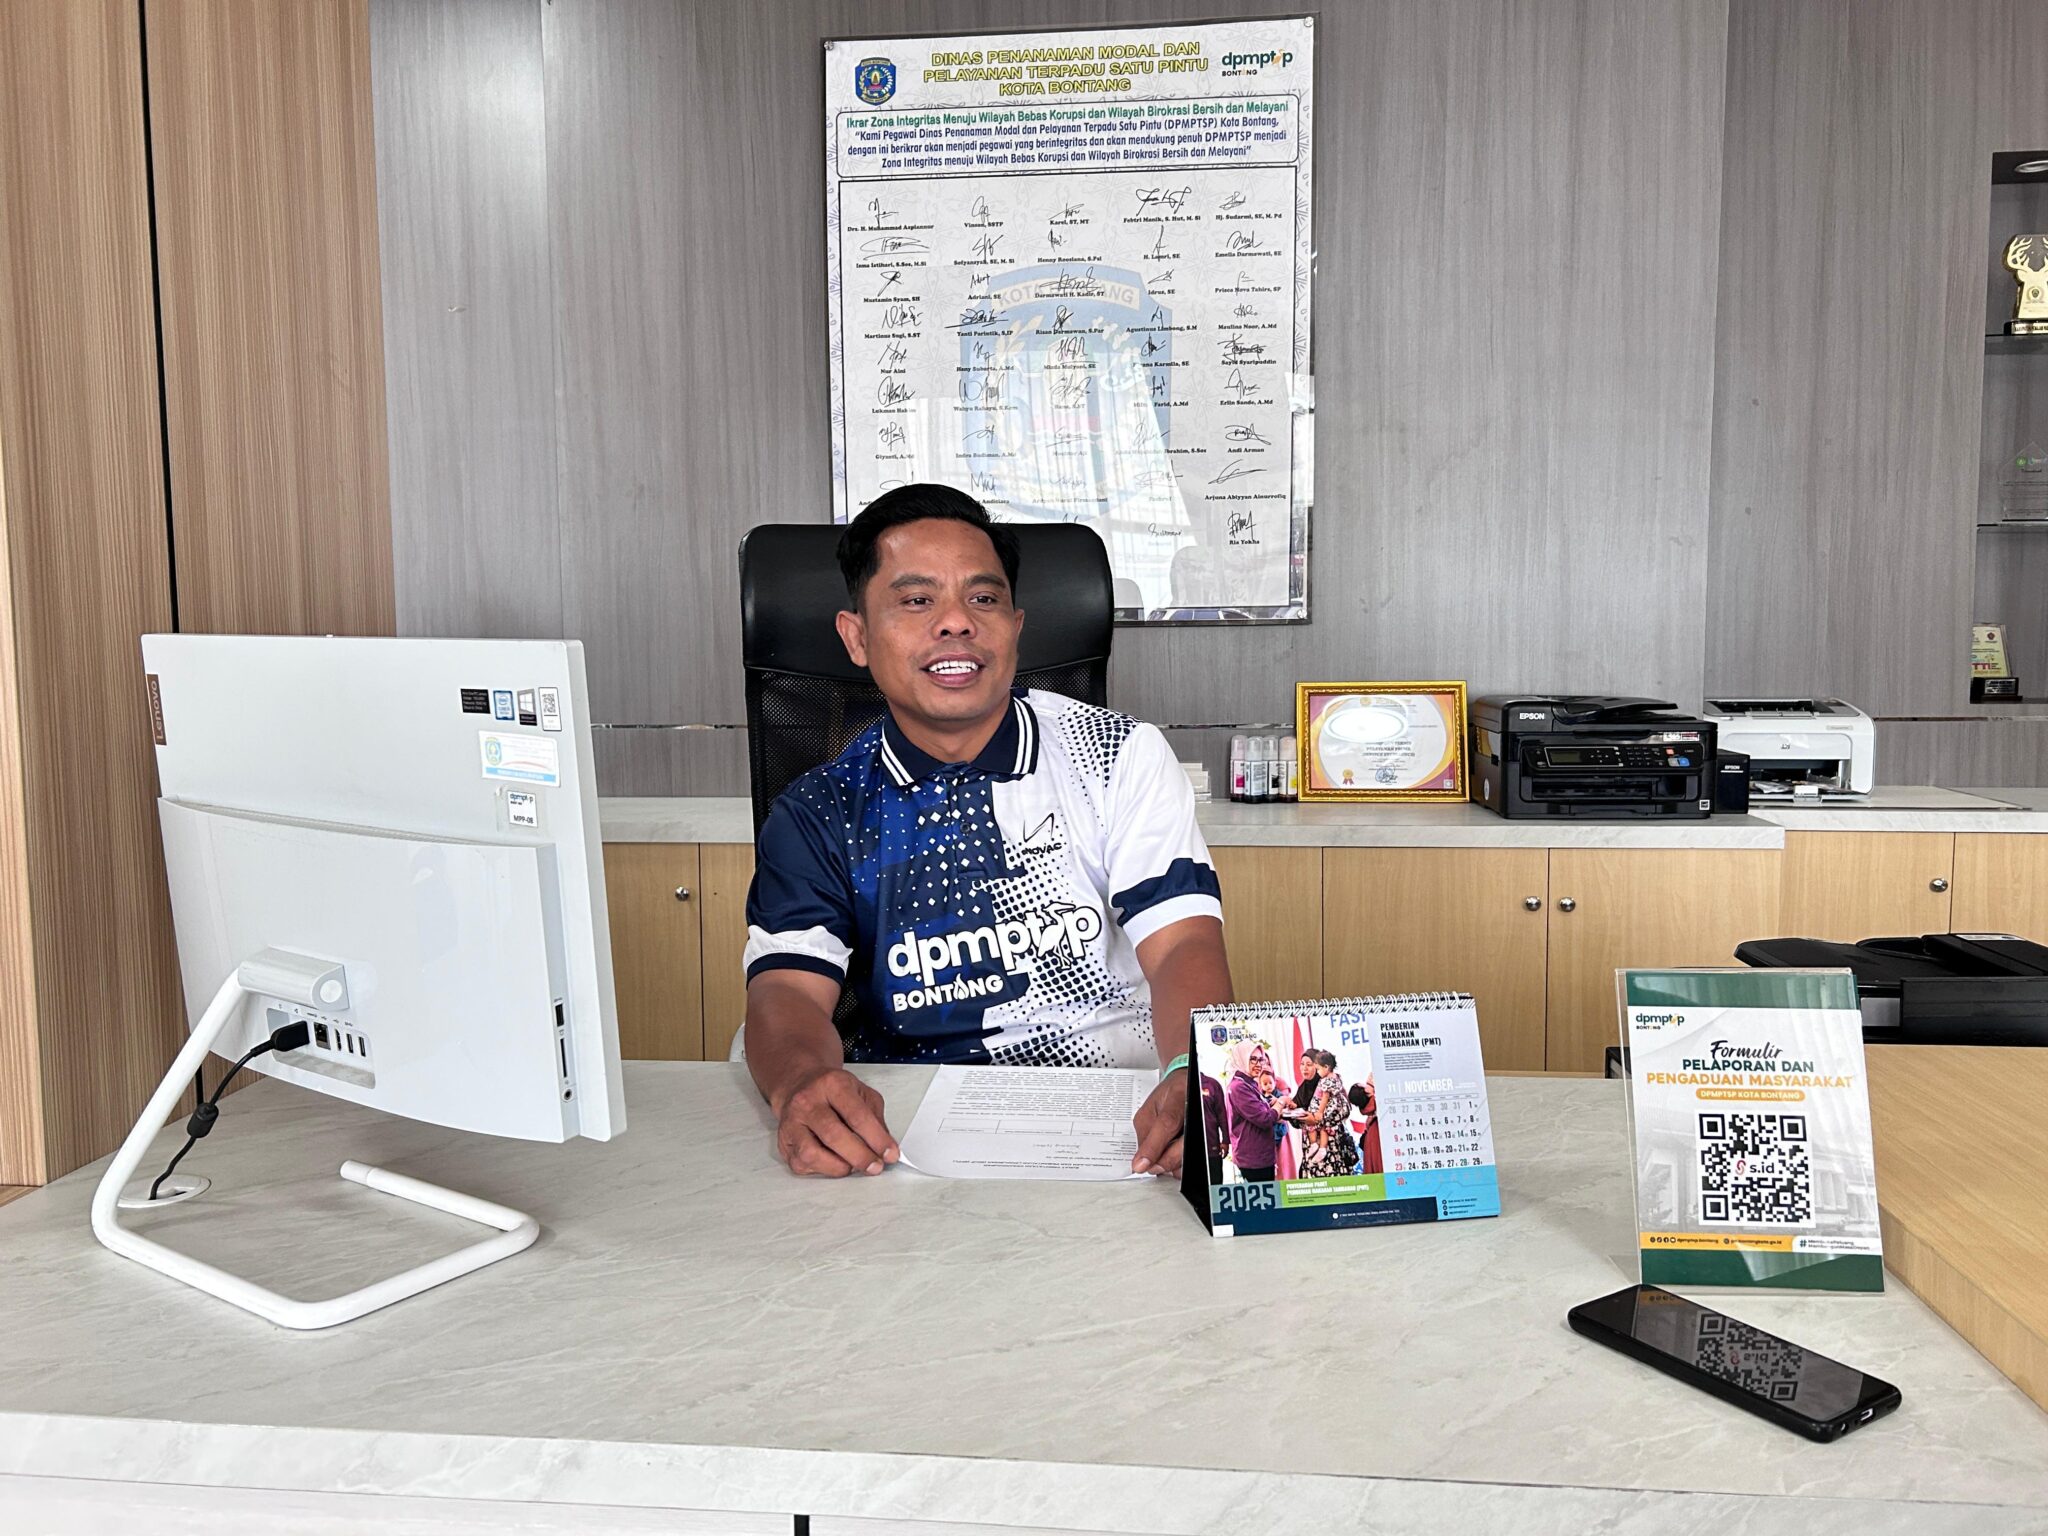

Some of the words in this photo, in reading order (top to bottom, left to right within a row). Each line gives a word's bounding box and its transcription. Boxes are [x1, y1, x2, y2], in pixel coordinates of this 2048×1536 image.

[932, 52, 982, 66] DINAS
[988, 47, 1094, 64] PENANAMAN
[1098, 44, 1159, 58] MODAL
[1163, 42, 1200, 56] DAN
[924, 67, 1022, 82] PELAYANAN
[1026, 63, 1105, 78] TERPADU
[1109, 61, 1154, 74] SATU
[1158, 58, 1208, 72] PINTU
[999, 82, 1045, 96] KOTA
[1048, 79, 1131, 93] BONTANG
[846, 117, 869, 128] Ikrar
[870, 116, 895, 127] Zona
[895, 114, 941, 127] Integritas
[942, 113, 977, 125] Menuju
[978, 111, 1016, 124] Wilayah
[1016, 110, 1047, 121] Bebas
[1048, 108, 1086, 121] Korupsi
[1087, 108, 1106, 118] dan
[1107, 106, 1145, 119] Wilayah
[1146, 104, 1190, 116] Birokrasi
[1191, 103, 1224, 114] Bersih
[1224, 103, 1244, 113] dan
[1245, 101, 1289, 114] Melayani
[855, 130, 880, 140] “Kami
[882, 129, 916, 141] Pegawai
[918, 129, 942, 138] Dinas
[944, 128, 992, 136] Penanaman
[994, 125, 1020, 135] Modal
[1021, 125, 1037, 134] dan
[1039, 124, 1081, 135] Pelayanan
[1084, 122, 1117, 133] Terpadu
[1118, 121, 1137, 130] Satu
[1139, 120, 1162, 130] Pintu
[1164, 118, 1217, 130] (DPMPTSP)
[1220, 117, 1239, 127] Kota
[1241, 116, 1278, 127] Bontang,
[848, 146, 876, 156] dengan
[878, 144, 889, 153] ini
[890, 143, 922, 153] berikrar
[924, 142, 943, 152] akan
[945, 141, 978, 152] menjadi
[979, 141, 1012, 151] pegawai
[1015, 141, 1034, 150] yang
[1036, 138, 1088, 149] berintegritas
[1088, 137, 1104, 146] dan
[1106, 137, 1126, 145] akan
[1127, 135, 1175, 145] mendukung
[1177, 134, 1202, 144] penuh
[1204, 132, 1252, 142] DPMPTSP
[1253, 131, 1287, 141] menjadi
[882, 158, 901, 167] Zona
[903, 157, 942, 168] Integritas
[944, 155, 974, 166] menuju
[976, 154, 1008, 165] Wilayah
[1010, 153, 1035, 163] Bebas
[1037, 152, 1068, 163] Korupsi
[1070, 152, 1086, 160] dan
[1088, 150, 1120, 161] Wilayah
[1122, 148, 1160, 159] Birokrasi
[1162, 148, 1188, 158] Bersih
[1190, 147, 1206, 156] dan
[1208, 145, 1250, 157] Melayani”
[1520, 712, 1545, 720] EPSON
[892, 973, 1004, 1012] BONTANG
[1380, 1022, 1419, 1031] PEMBERIAN
[1342, 1028, 1369, 1046] PEL
[1381, 1031, 1414, 1039] MAKANAN
[1382, 1039, 1420, 1048] TAMBAHAN
[1422, 1038, 1442, 1047] (PMT)
[1710, 1040, 1783, 1059] Formulir
[1682, 1059, 1776, 1072] PELAPORAN
[1782, 1061, 1814, 1072] DAN
[1404, 1078, 1454, 1093] NOVEMBER
[1647, 1073, 1744, 1086] PENGADUAN
[1750, 1075, 1853, 1088] MASYARAKAT
[1701, 1090, 1736, 1098] DPMPTSP
[1761, 1092, 1800, 1100] BONTANG
[1468, 1101, 1473, 1109] 1
[1405, 1119, 1410, 1127] 3
[1407, 1148, 1414, 1156] 17
[1420, 1147, 1427, 1155] 18
[1433, 1146, 1440, 1154] 19
[1445, 1145, 1453, 1153] 20
[1458, 1144, 1466, 1152] 21
[1471, 1143, 1478, 1151] 22
[1395, 1163, 1403, 1171] 23
[1472, 1157, 1481, 1166] 29
[1750, 1161, 1775, 1174] s.id
[1218, 1184, 1276, 1213] 2025
